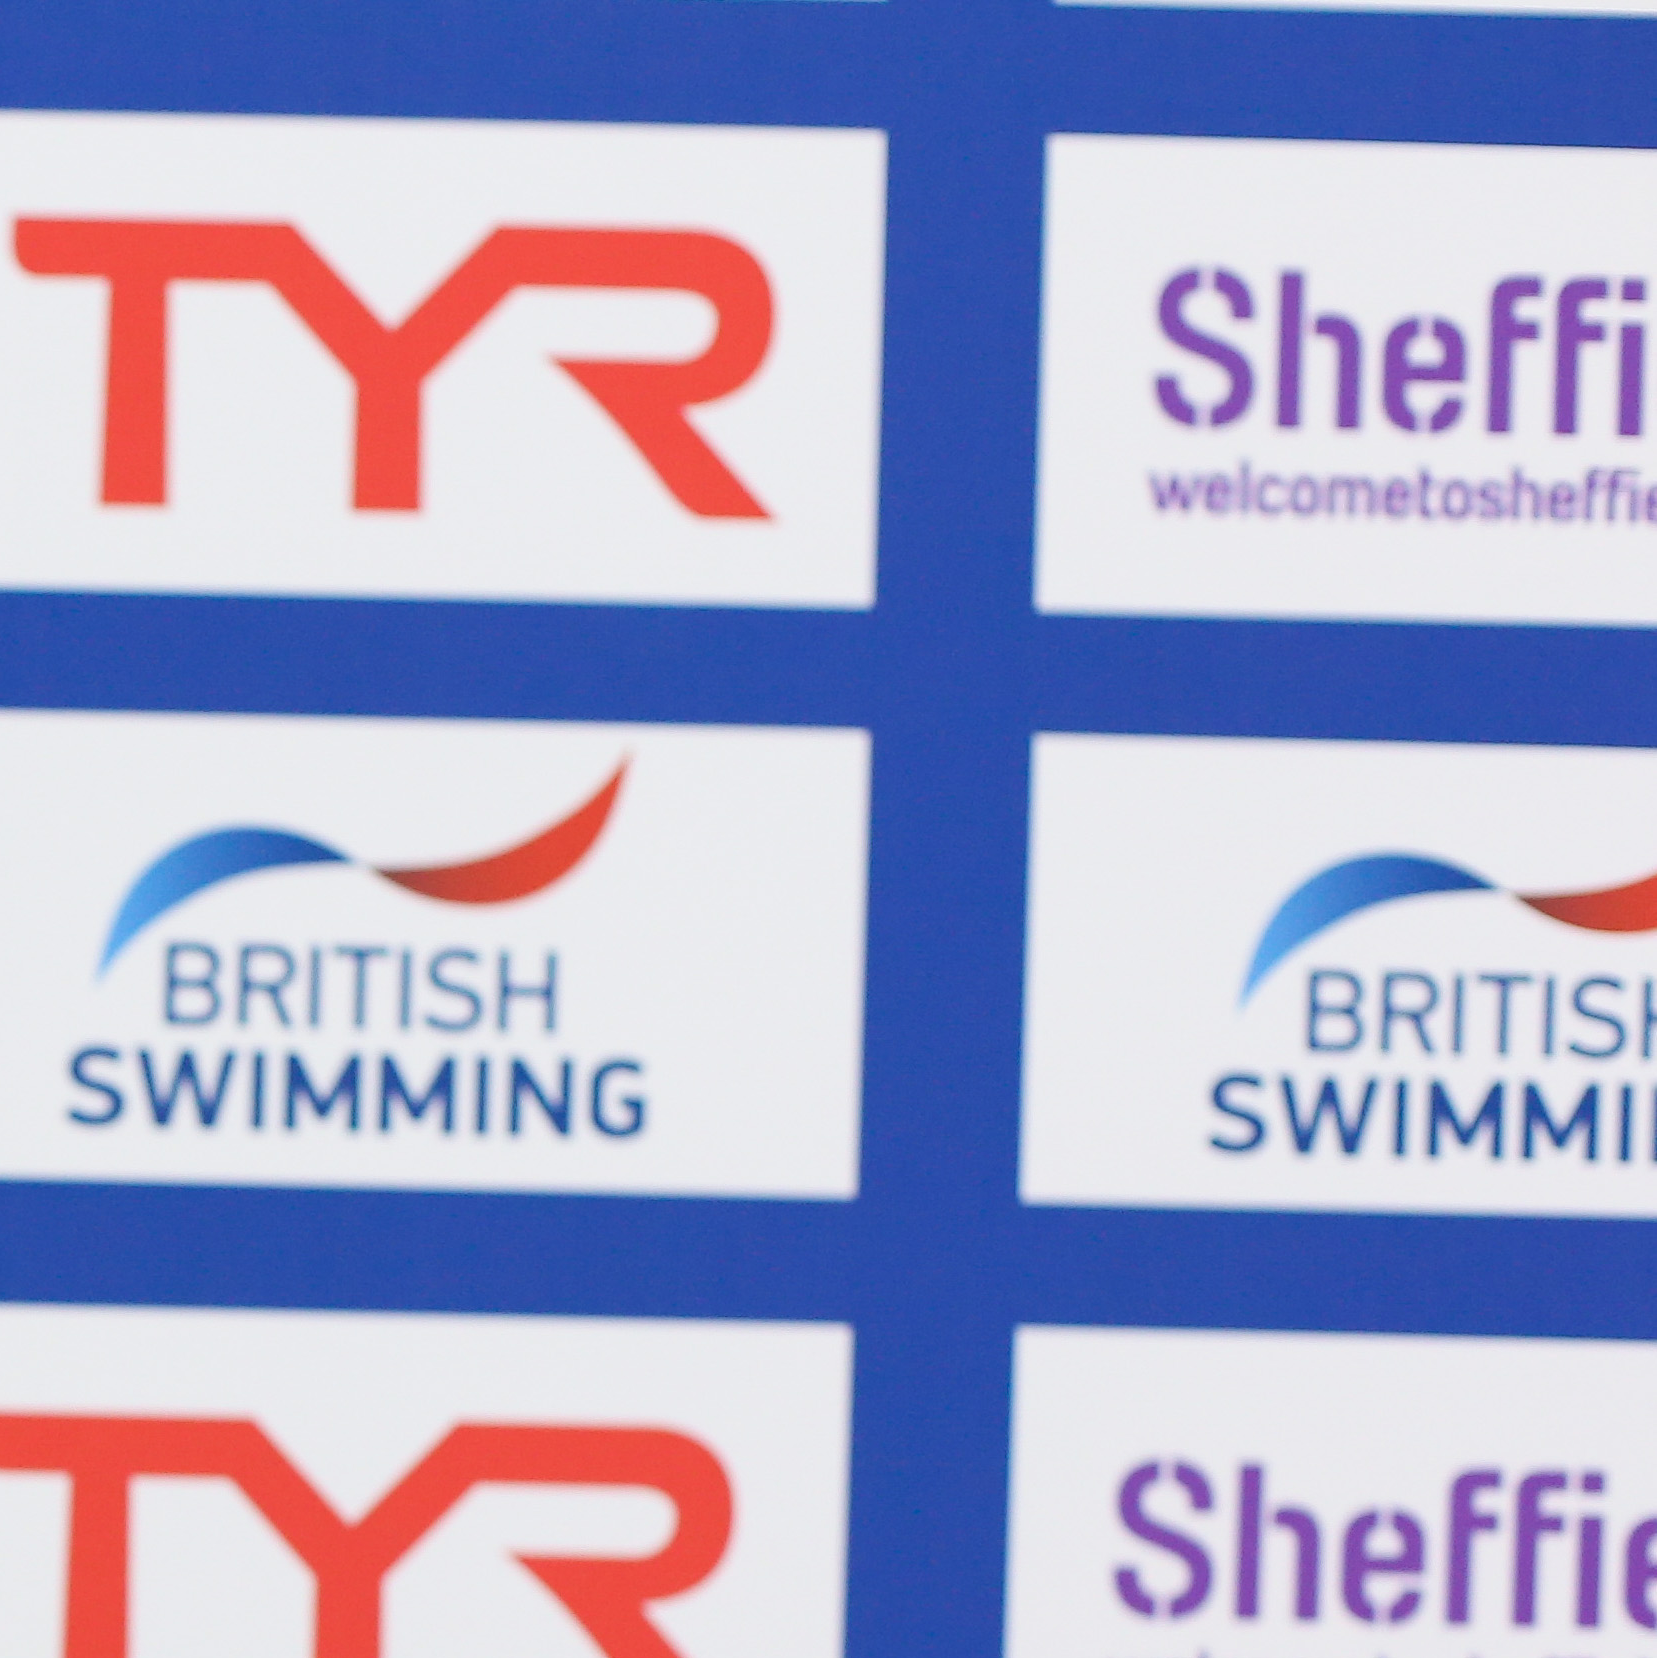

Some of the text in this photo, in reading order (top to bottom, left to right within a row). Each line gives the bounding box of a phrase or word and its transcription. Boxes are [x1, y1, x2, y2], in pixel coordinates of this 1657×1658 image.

[10, 215, 777, 522] TYR
[1153, 267, 1649, 438] Sheffi
[163, 940, 559, 1034] BRITISH
[1305, 968, 1657, 1059] BRITIS
[68, 1045, 647, 1139] SWIMMING
[1209, 1072, 1657, 1164] SWIMMI
